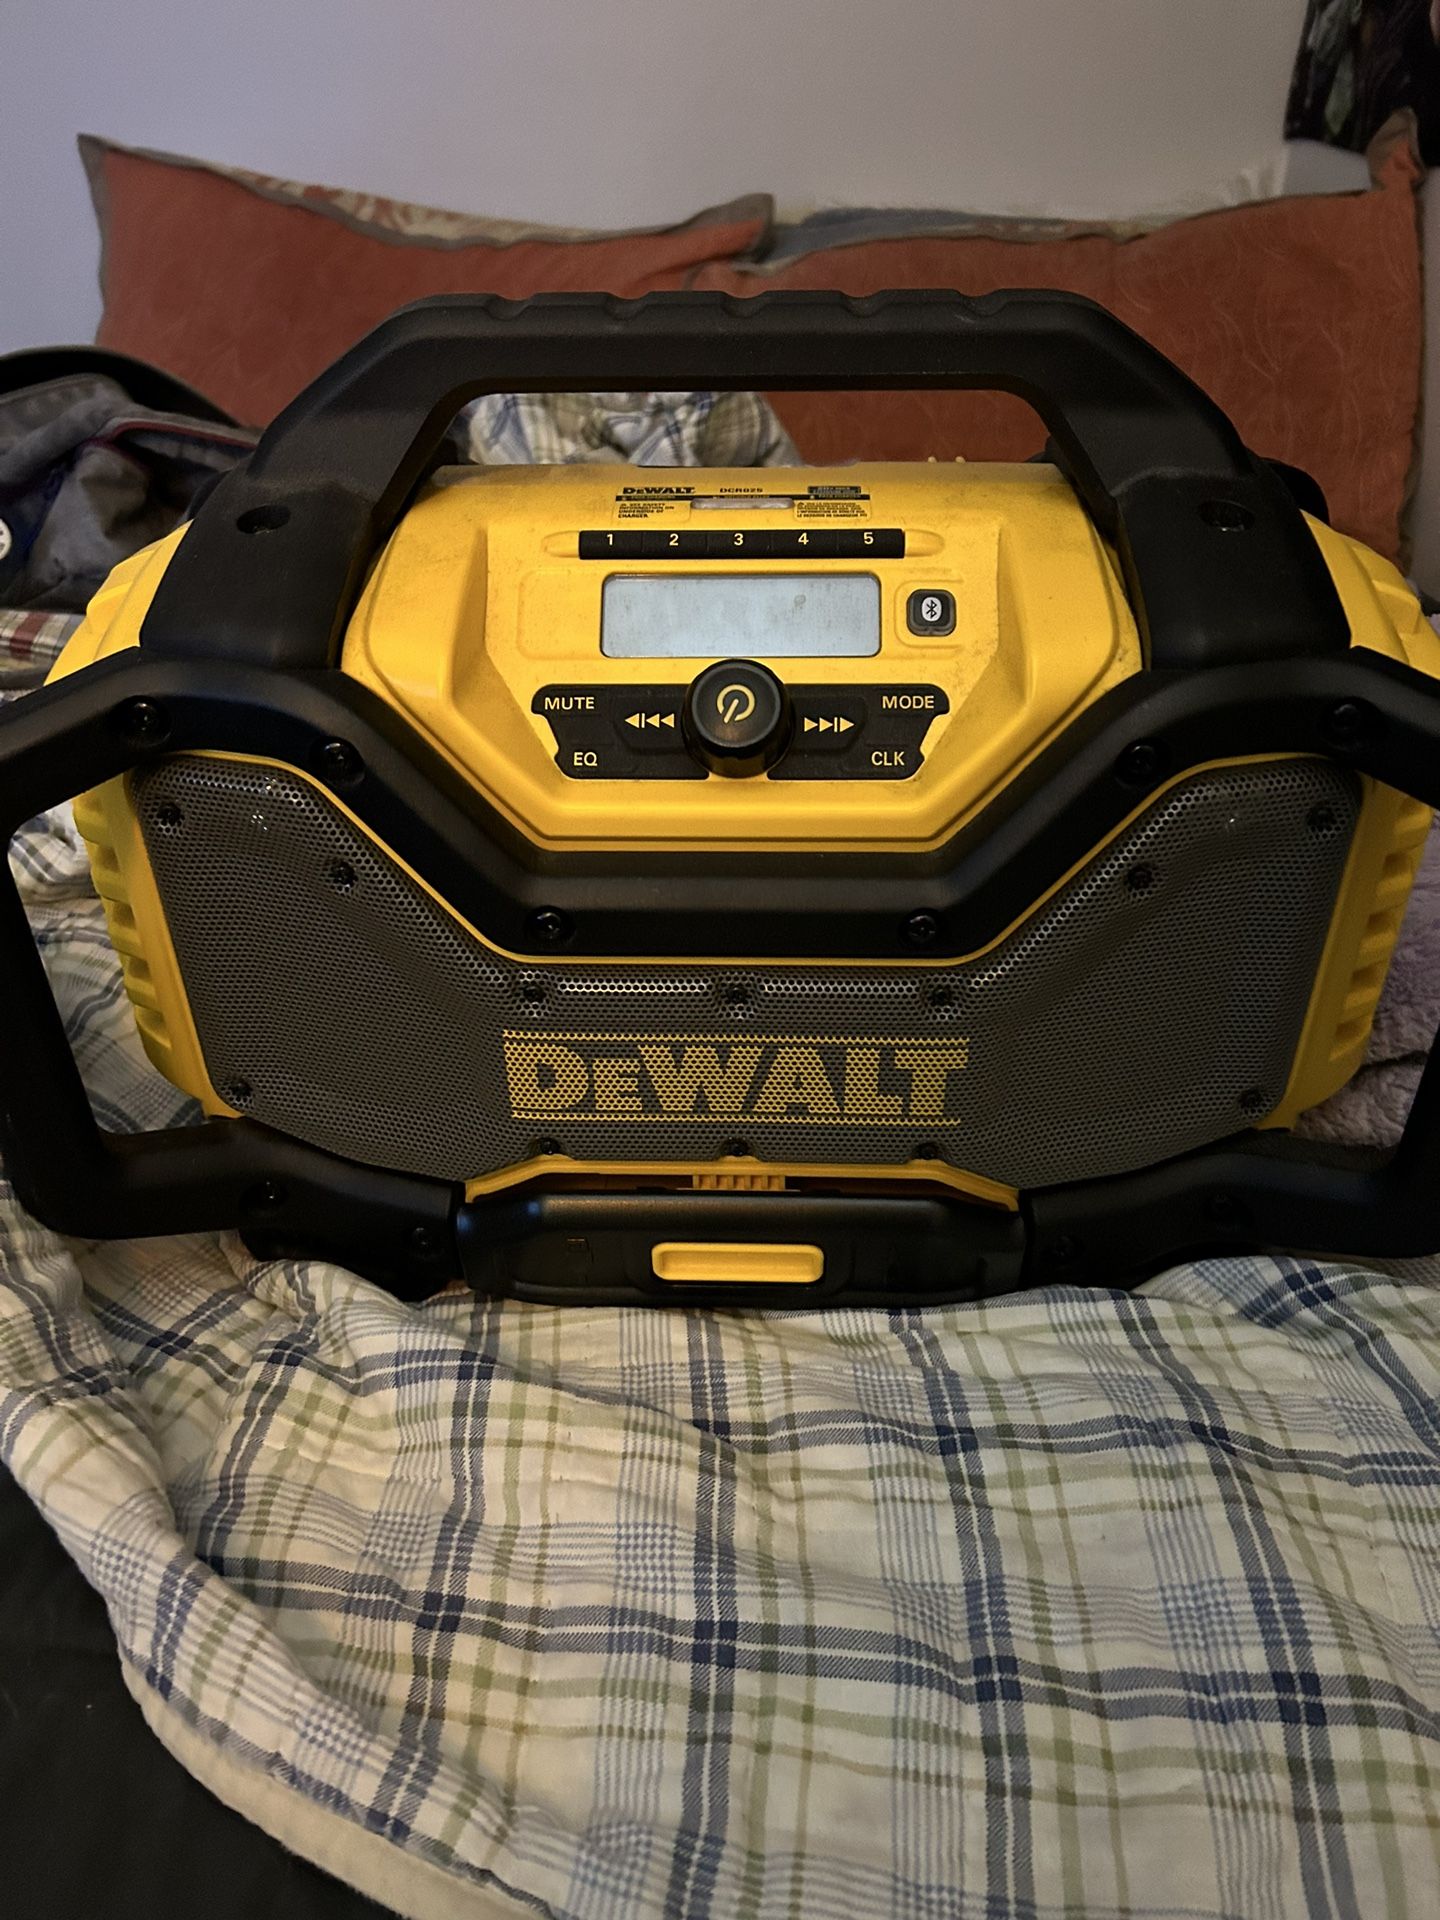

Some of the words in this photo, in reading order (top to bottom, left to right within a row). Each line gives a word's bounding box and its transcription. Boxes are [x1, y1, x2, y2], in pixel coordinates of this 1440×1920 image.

[606, 533, 613, 546] 1
[669, 533, 679, 546] 2
[733, 533, 744, 546] 3
[797, 533, 809, 545] 4
[863, 532, 874, 545] 5
[544, 697, 595, 711] MUTE
[882, 695, 935, 710] MODE
[573, 751, 598, 767] EQ
[871, 751, 905, 767] CLK
